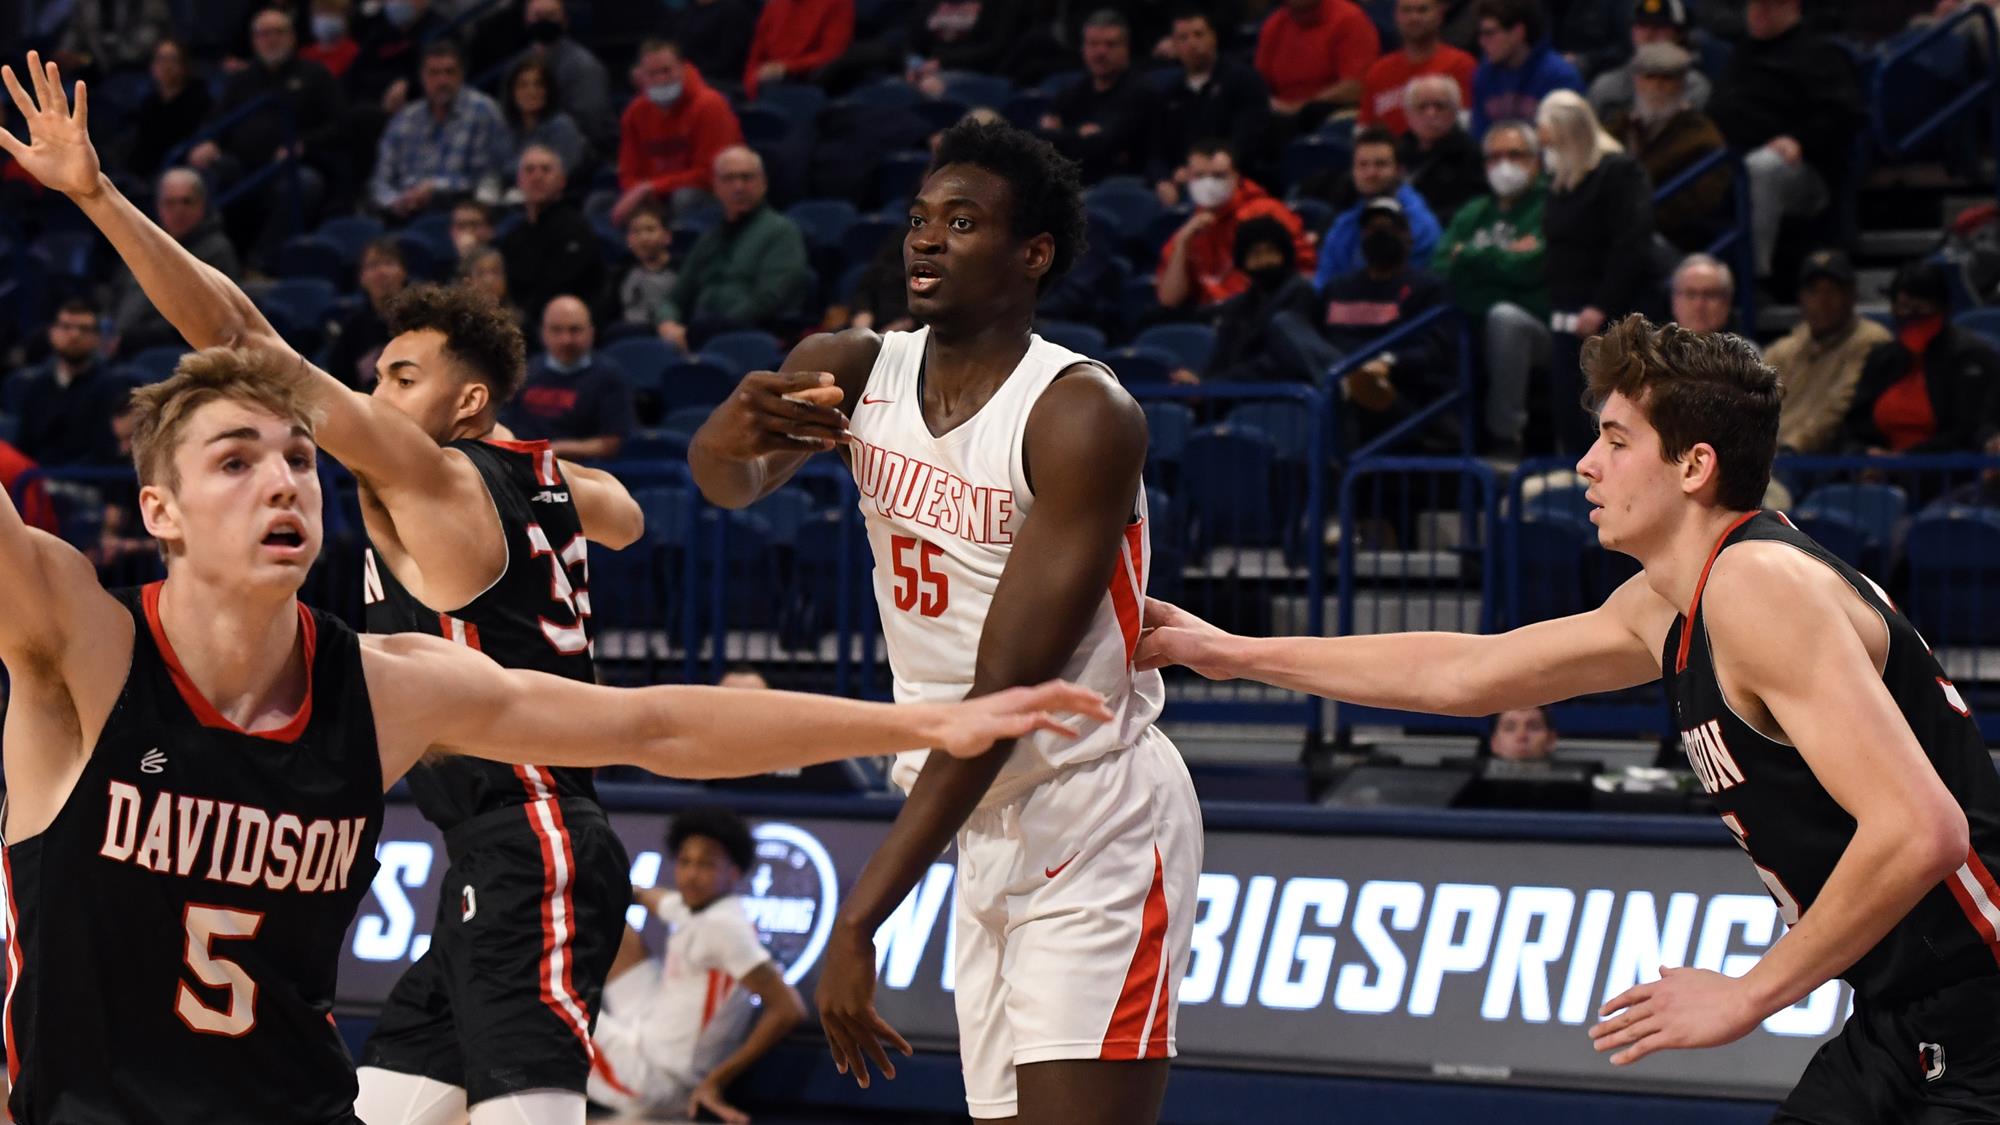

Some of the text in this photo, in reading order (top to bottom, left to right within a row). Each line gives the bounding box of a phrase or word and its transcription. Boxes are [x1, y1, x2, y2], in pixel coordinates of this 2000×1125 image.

[891, 534, 949, 618] 55
[99, 779, 367, 893] DAVIDSON
[173, 901, 265, 1038] 5
[1178, 872, 1855, 1038] BIGSPRING
